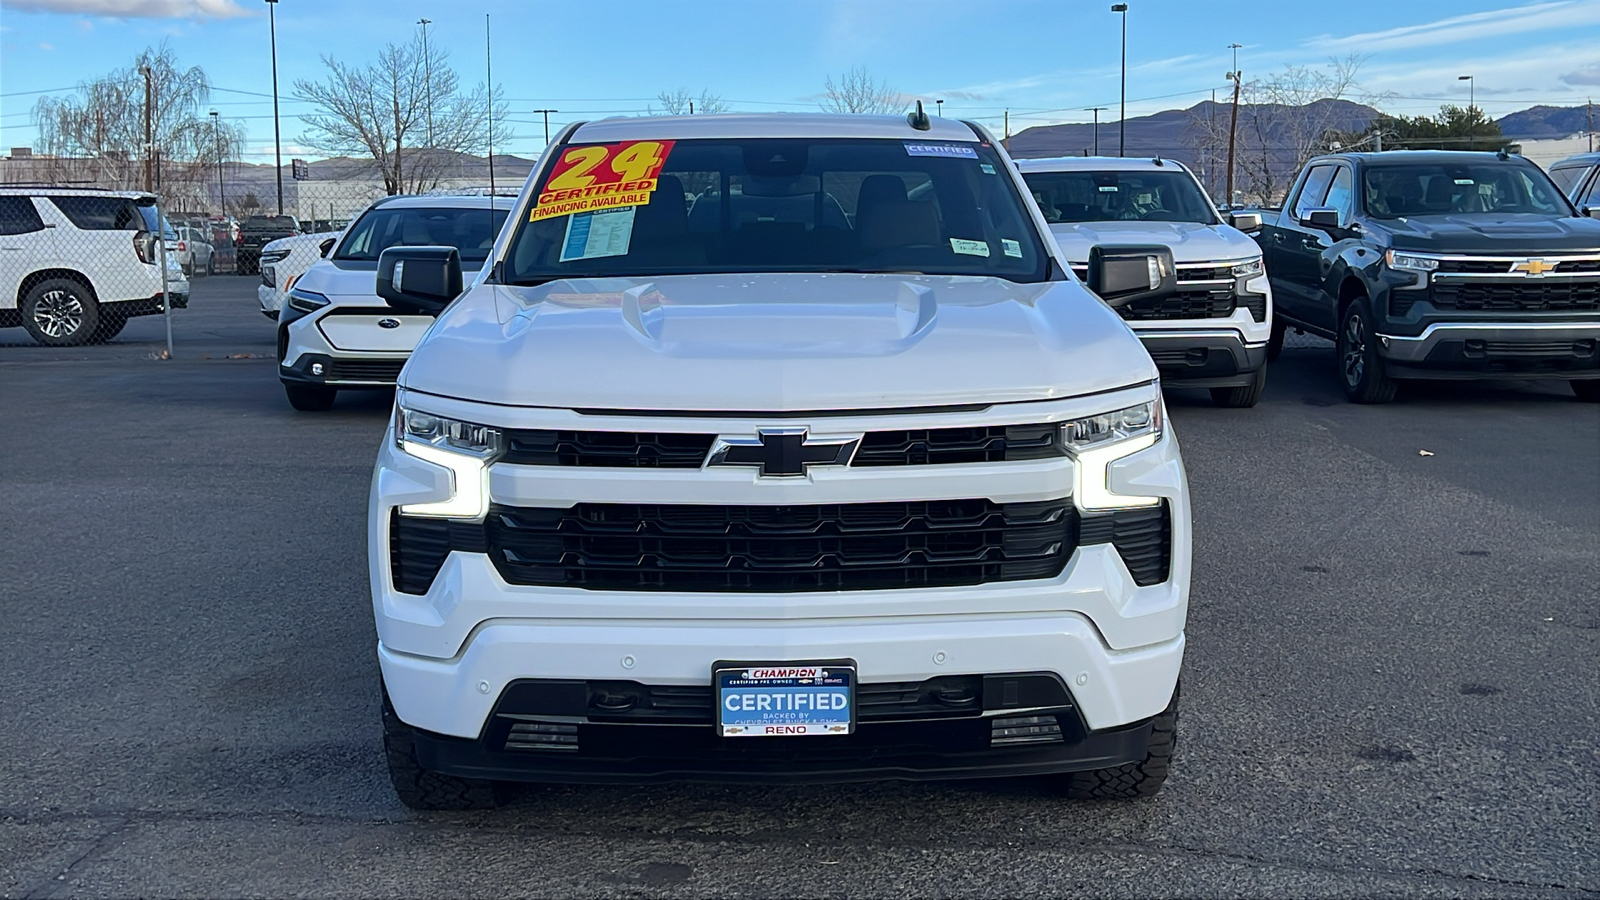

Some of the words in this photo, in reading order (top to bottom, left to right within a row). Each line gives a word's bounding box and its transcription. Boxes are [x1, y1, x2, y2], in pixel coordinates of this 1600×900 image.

[908, 145, 973, 154] CERTIFIED
[548, 142, 664, 190] 24
[539, 181, 653, 204] CERTIFIED
[533, 203, 587, 218] FINANCING
[590, 194, 646, 208] AVAILABLE
[753, 669, 817, 679] CHAMPION
[725, 693, 848, 711] CERTIFIED
[765, 726, 807, 734] RENO
